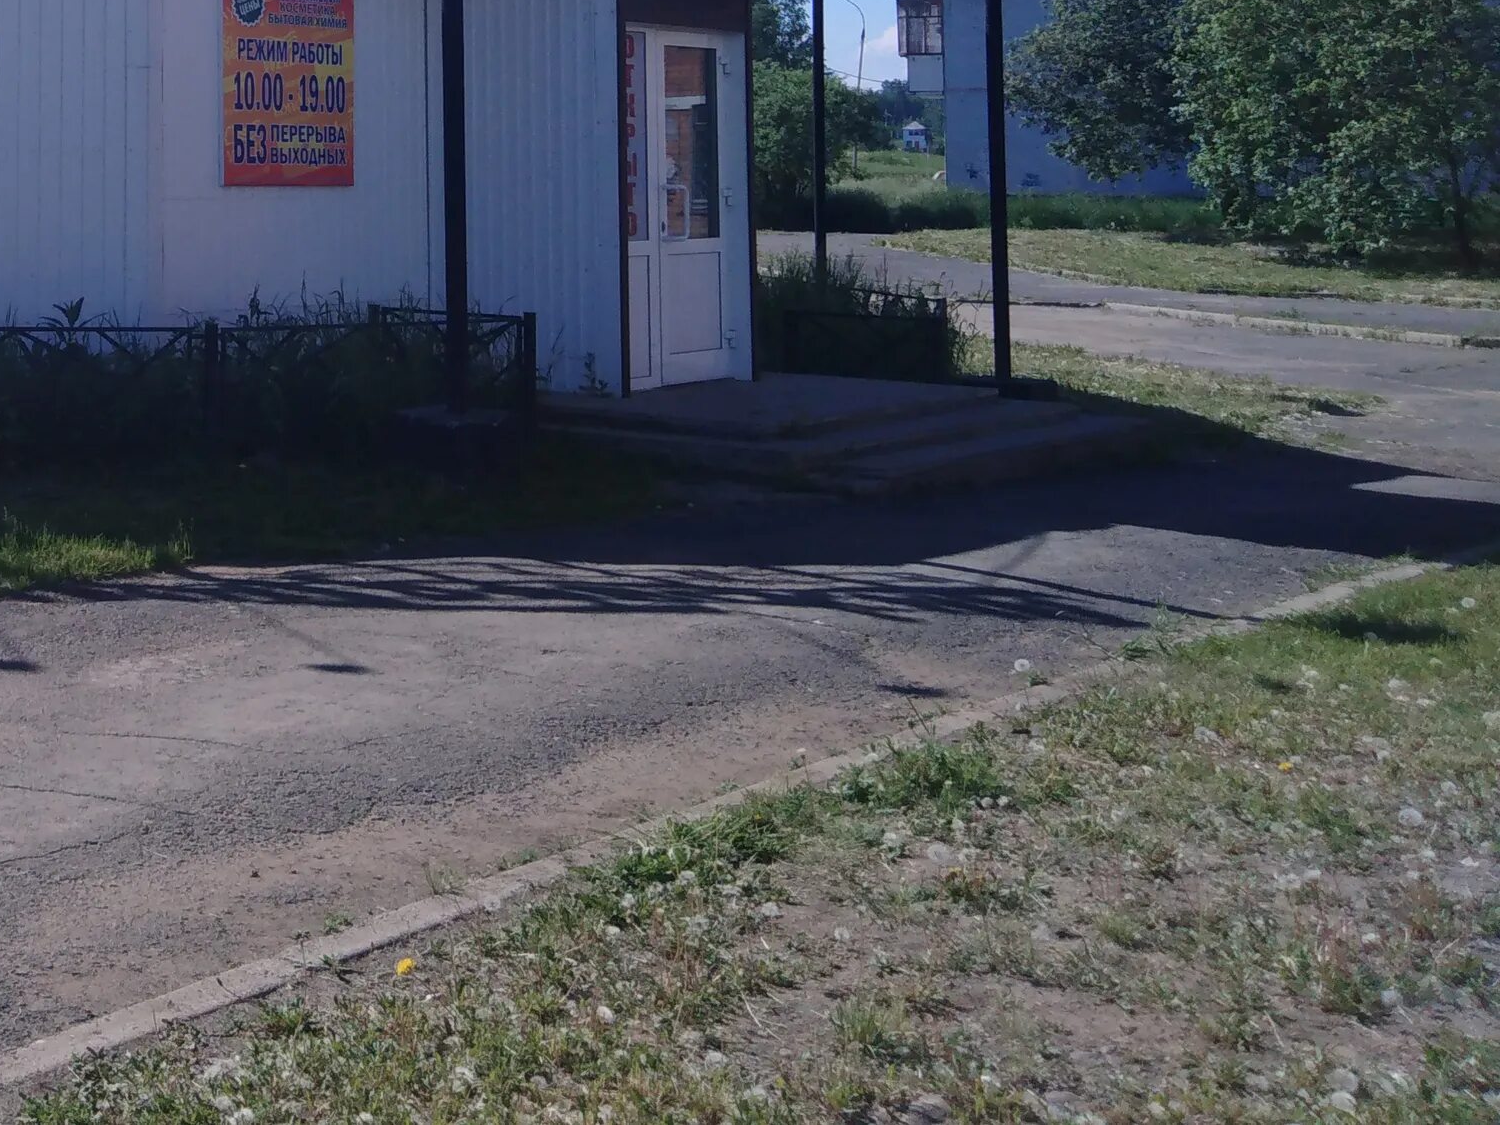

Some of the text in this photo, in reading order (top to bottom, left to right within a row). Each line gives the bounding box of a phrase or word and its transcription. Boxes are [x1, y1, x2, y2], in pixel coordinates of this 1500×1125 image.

[268, 13, 348, 29] БЫТОВАЯ ХИМИЯ
[279, 2, 335, 16] КОСМЕТИКА
[237, 38, 343, 66] РЕЖИМ РАБОТЫ
[234, 71, 283, 112] 10.00
[299, 74, 346, 114] 19.00
[233, 124, 346, 165] БЕЗ ПЕРЕРЫВА
[270, 147, 347, 167] ВЫХОДНЫХ
